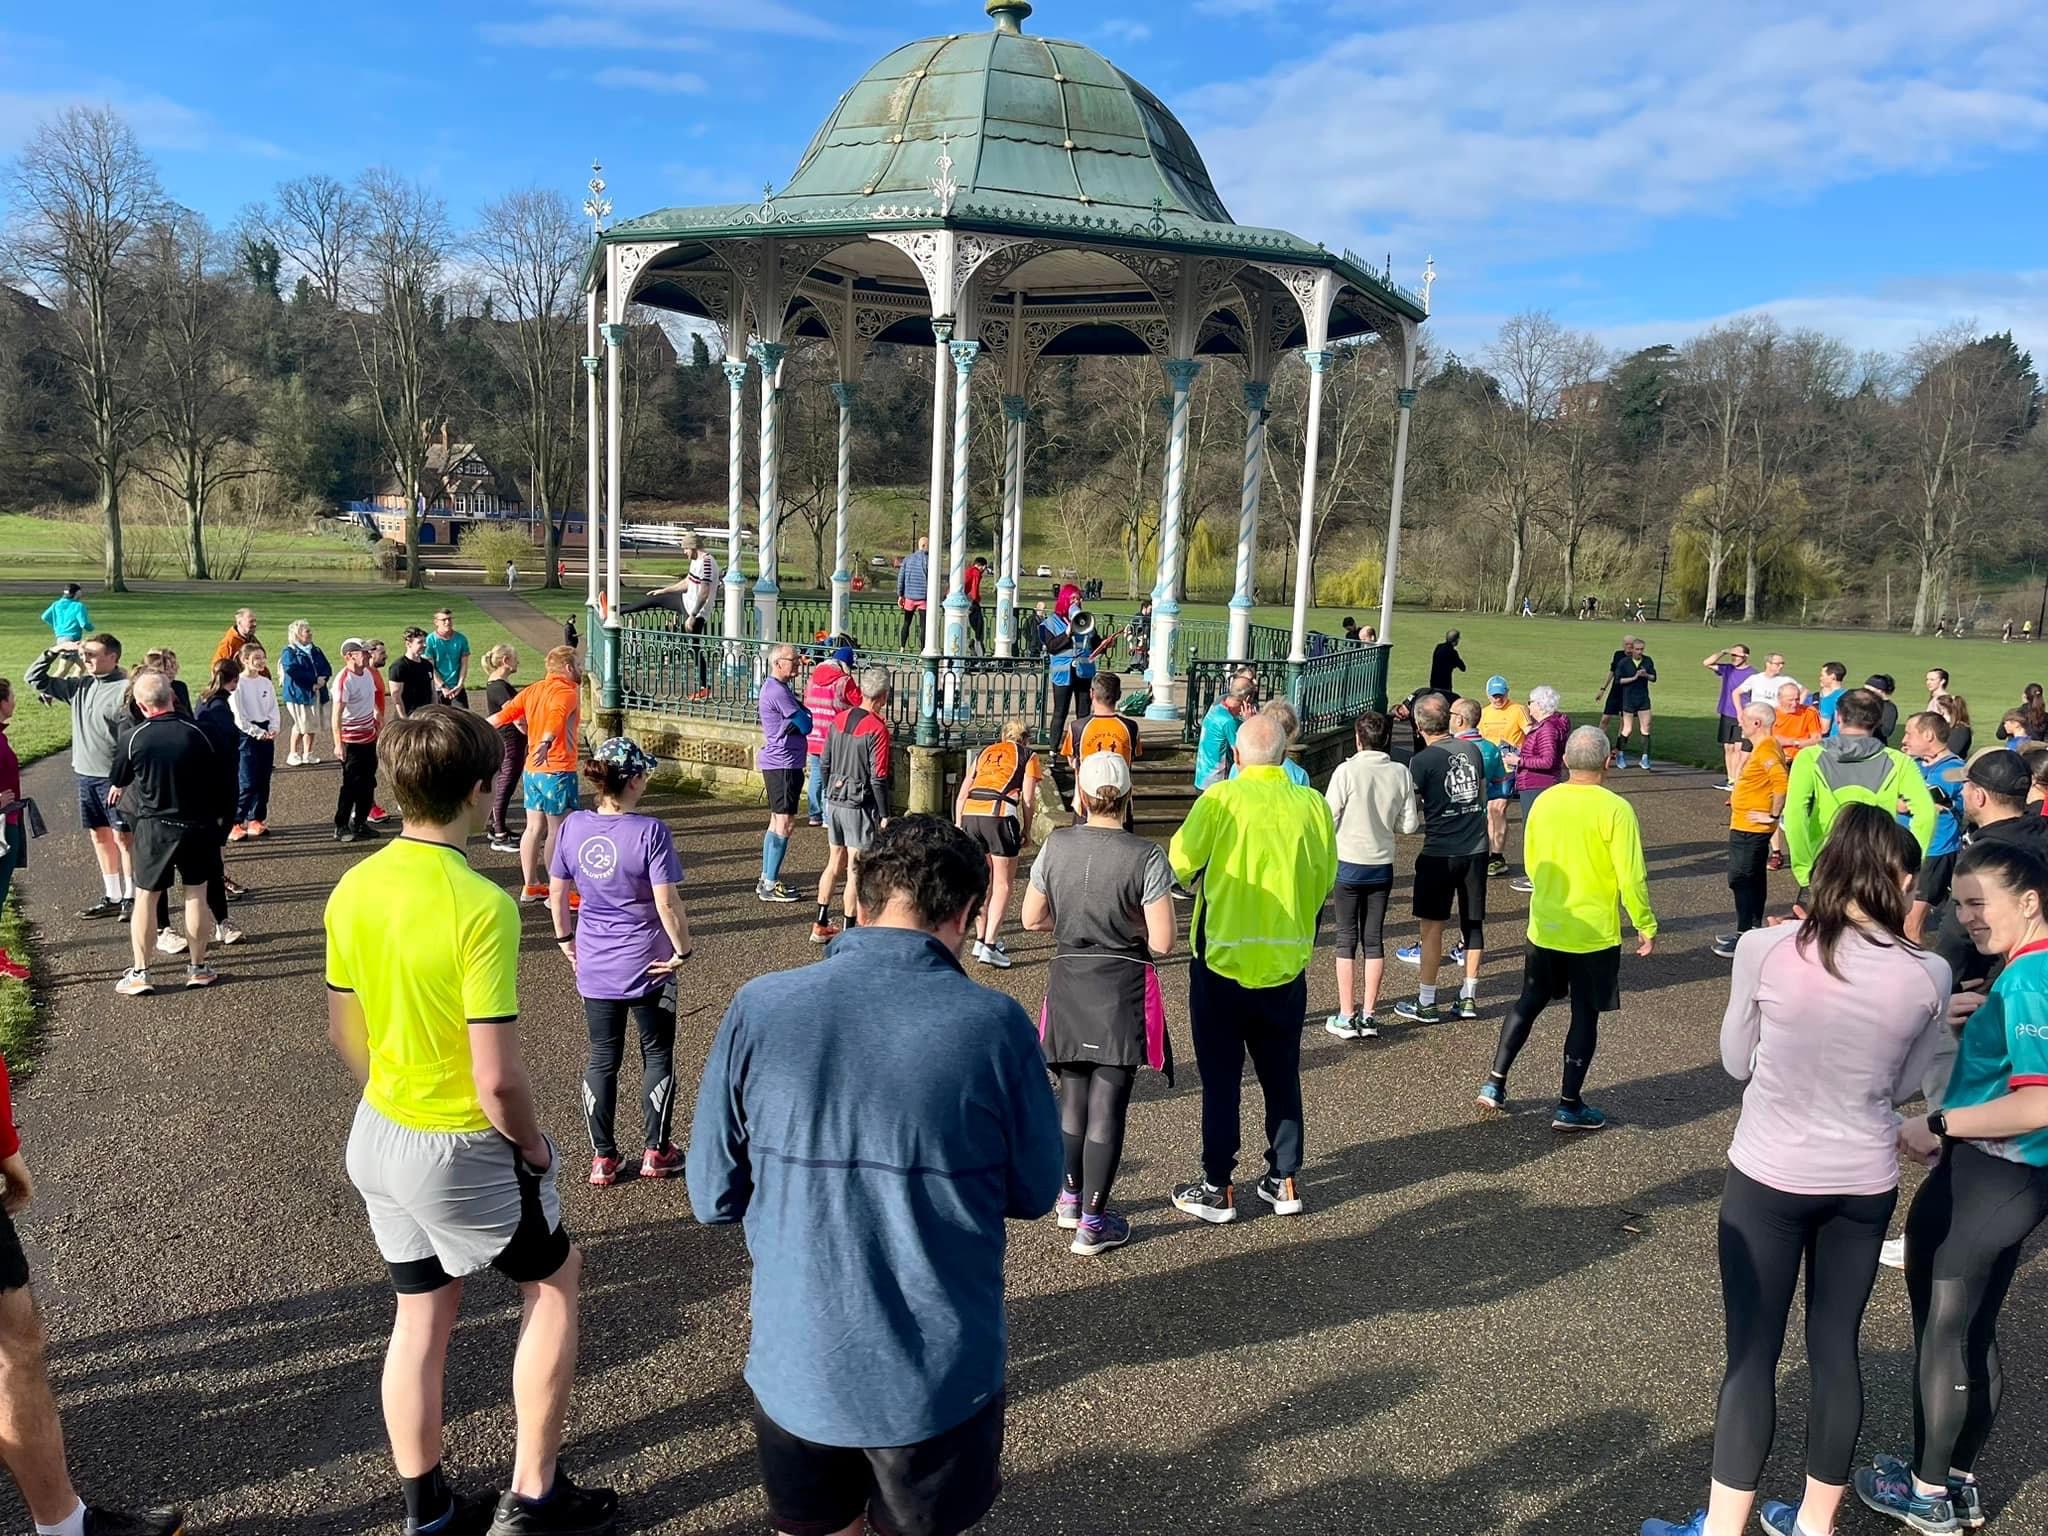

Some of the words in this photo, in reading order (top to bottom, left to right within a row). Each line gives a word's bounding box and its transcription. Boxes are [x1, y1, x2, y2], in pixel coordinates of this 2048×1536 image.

[1446, 765, 1476, 786] 13.1
[1451, 781, 1477, 795] MILES
[593, 854, 611, 868] 25
